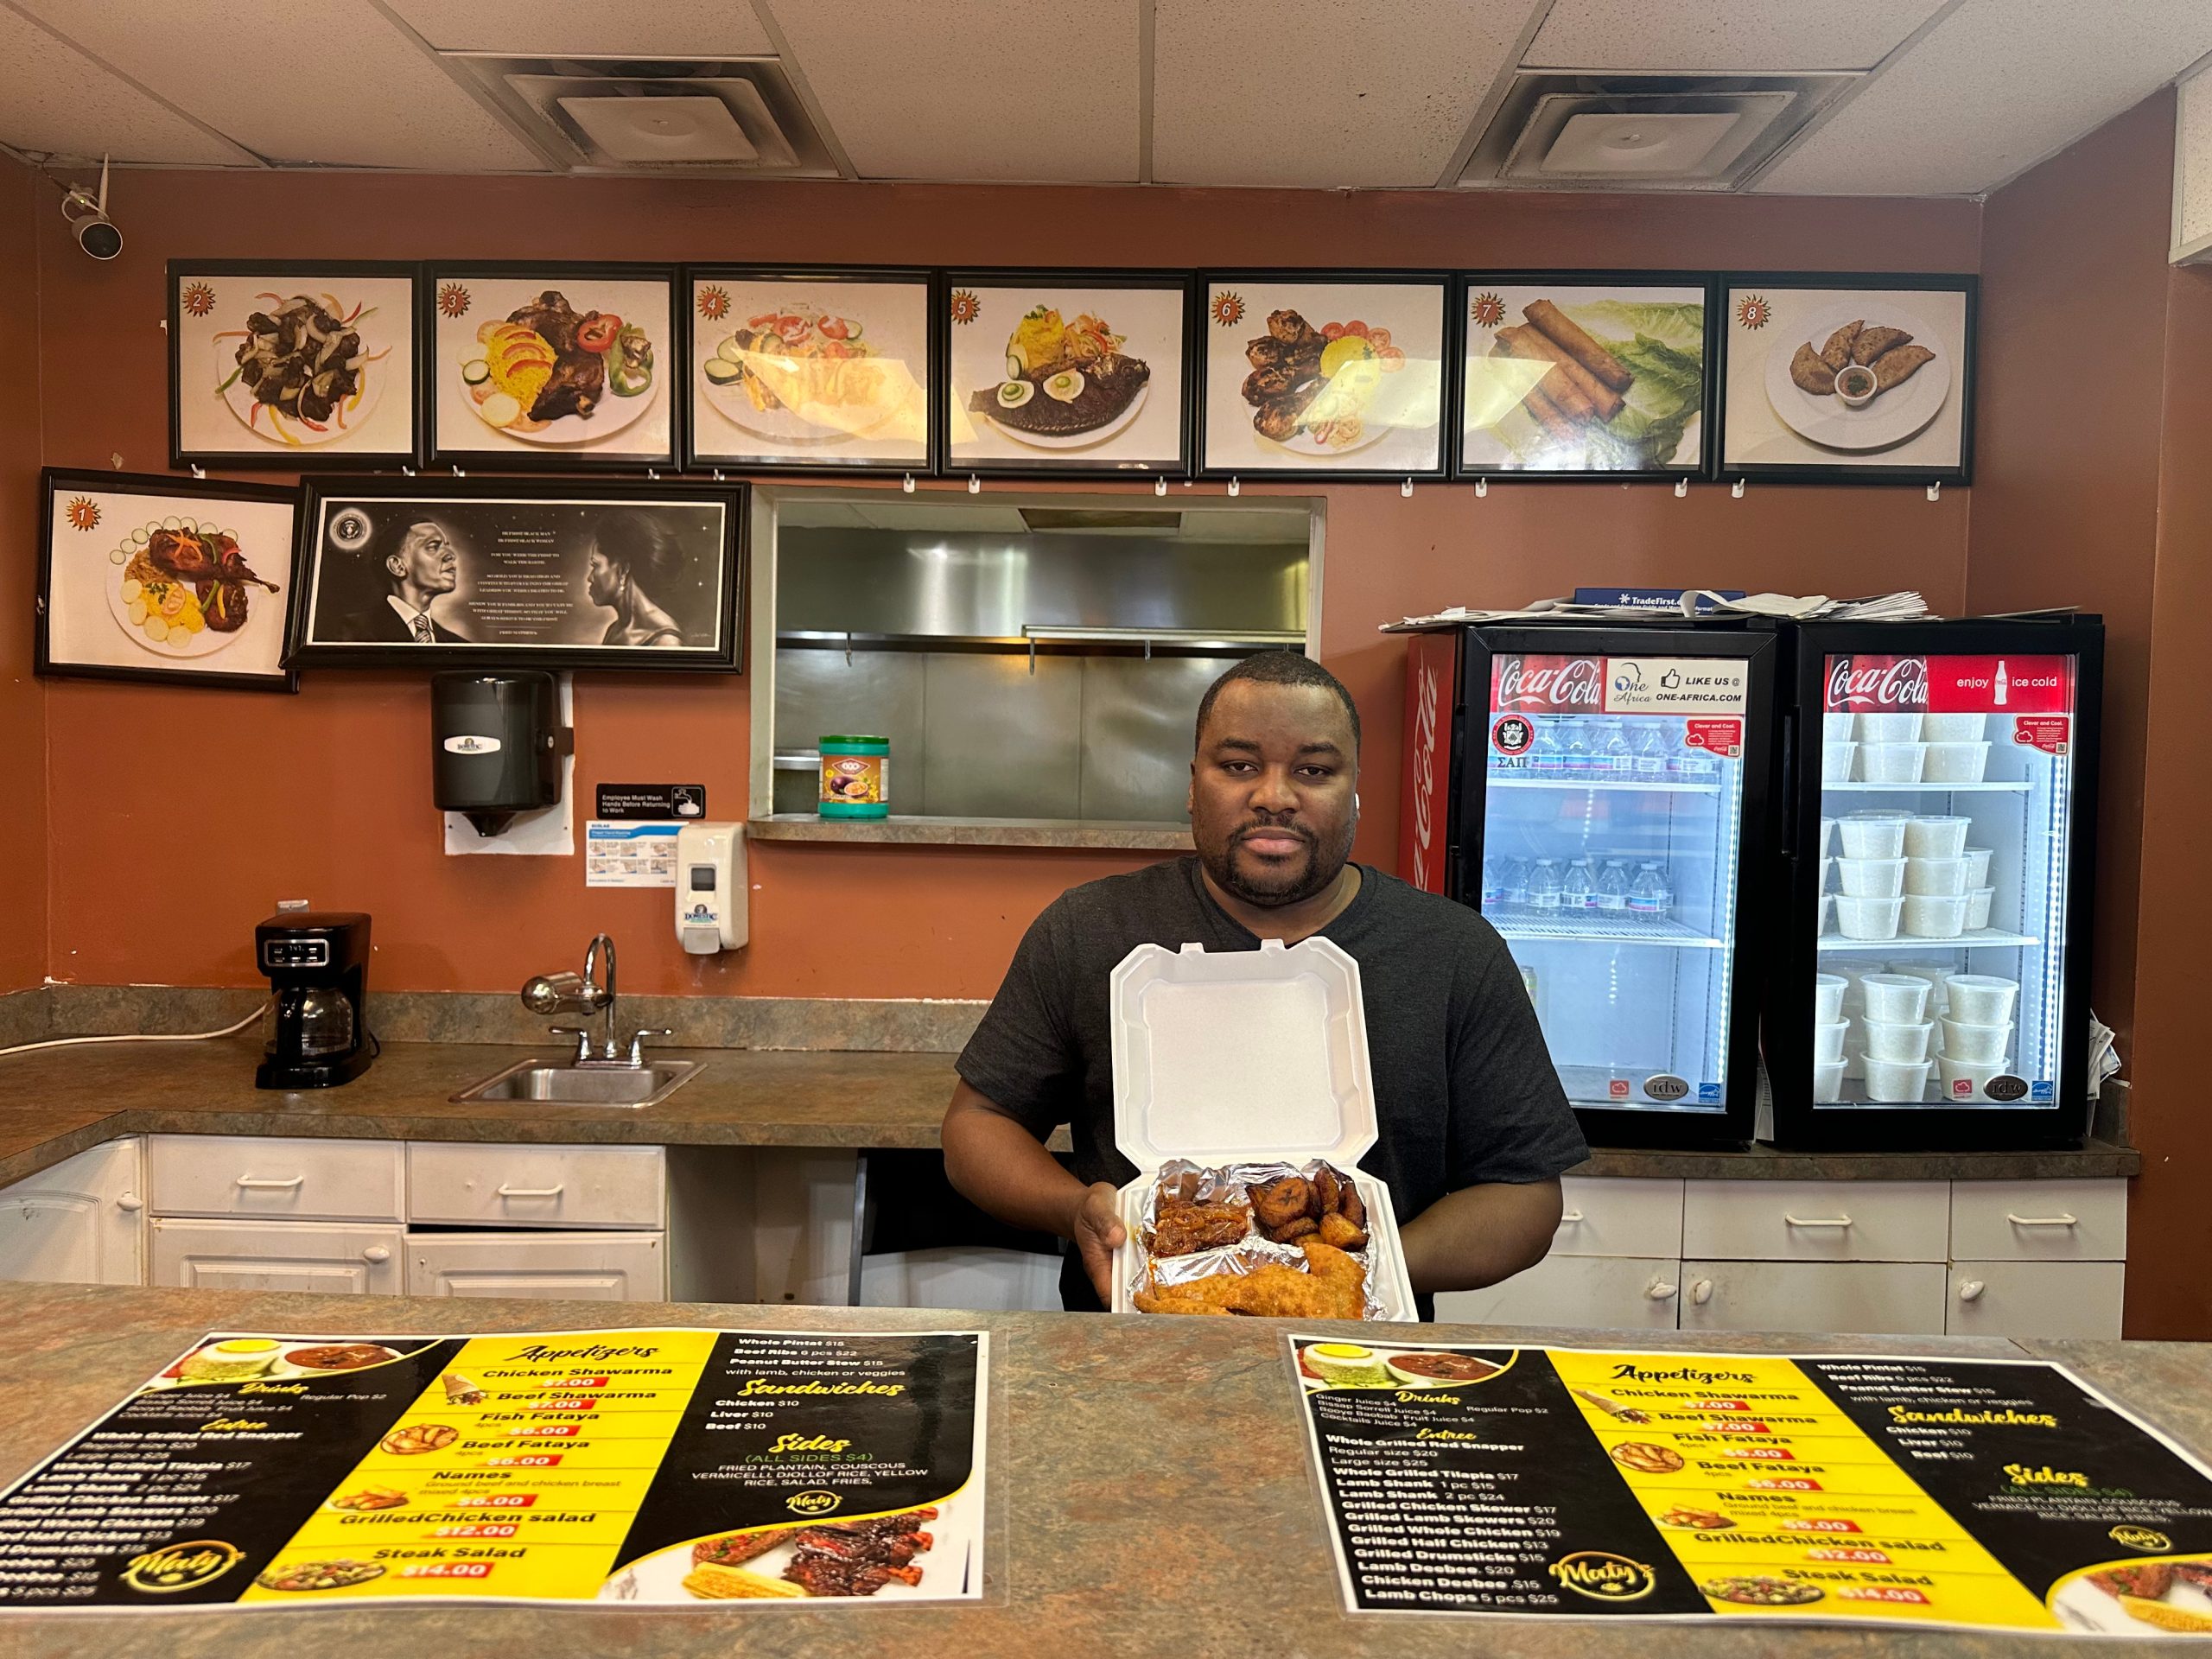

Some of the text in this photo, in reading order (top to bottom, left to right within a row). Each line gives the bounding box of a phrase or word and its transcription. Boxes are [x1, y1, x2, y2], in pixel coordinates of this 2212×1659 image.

[193, 294, 202, 307] 2
[448, 295, 457, 308] 3
[708, 297, 716, 310] 4
[957, 302, 966, 315] 5
[1222, 302, 1231, 316] 6
[1482, 304, 1491, 318] 7
[1747, 306, 1757, 321] 8
[78, 508, 86, 521] 1
[1498, 659, 1600, 707] Coca-Cola
[1686, 677, 1712, 685] LIKE
[1732, 677, 1740, 687] @
[1827, 659, 1929, 707] Coca-Cola
[1956, 677, 1989, 689] enjoy
[2012, 677, 2028, 687] ice
[2031, 677, 2057, 687] cold
[1614, 693, 1652, 704] Africa
[1656, 693, 1742, 702] ONE-AFRICA.COM
[504, 1345, 660, 1363] Appetizers
[1610, 1364, 1758, 1384] Appetizers
[238, 1382, 309, 1395] Drinks
[542, 1378, 594, 1387] $7.00
[737, 1378, 906, 1396] Sandwiches
[497, 1392, 546, 1401] Beef
[1315, 1393, 1351, 1403] Ginger
[1395, 1390, 1460, 1405] Drinks
[1610, 1389, 1799, 1400] Chicken Shawarma
[527, 1401, 582, 1409] $7.00
[1319, 1406, 1353, 1417] Booye
[1465, 1405, 1533, 1415] Regular Pop
[530, 1413, 600, 1421] Fataya
[1320, 1412, 1370, 1424] Cocktails
[1709, 1414, 1818, 1424] Shawarma
[1888, 1405, 2058, 1427] Sandwiches
[509, 1427, 569, 1436] $6.00
[1415, 1427, 1478, 1441] Entree
[461, 1440, 590, 1450] Beef Fataya
[767, 1433, 852, 1453] Sides
[1325, 1433, 1524, 1452] Whole Grilled Red Snapper
[1672, 1433, 1793, 1445] Fish Fataya
[789, 1453, 841, 1463] SIDES
[1329, 1446, 1380, 1458] Regular
[486, 1456, 551, 1466] $6.00
[1331, 1457, 1428, 1467] Large size $25
[1696, 1461, 1826, 1474] Beef Fataya
[1332, 1467, 1519, 1481] Whole Grilled Tilapia $17
[2003, 1464, 2088, 1487] Sides
[1336, 1478, 1495, 1490] Lamb Shank $15
[456, 1496, 524, 1507] $6.00
[1338, 1490, 1505, 1501] Lamb Shank $24
[1715, 1491, 1796, 1503] Names
[1341, 1501, 1556, 1514] Grilled Chicken Skewer $17
[340, 1512, 596, 1525] GrilledChicken salad
[1344, 1512, 1555, 1525] Grilled Lamb Skewers $20
[1347, 1524, 1533, 1537] Grilled Whole Chicken
[1351, 1536, 1521, 1549] Grilled Half Chicken
[1878, 1539, 1947, 1552] salad
[373, 1547, 527, 1560] Steak Salad
[1354, 1548, 1516, 1562] Grilled Drumsticks
[1357, 1561, 1407, 1572] Lamb
[1360, 1574, 1434, 1586] Chicken
[1782, 1568, 1935, 1586] Steak Salad
[1364, 1588, 1478, 1602] Lamb Chops
